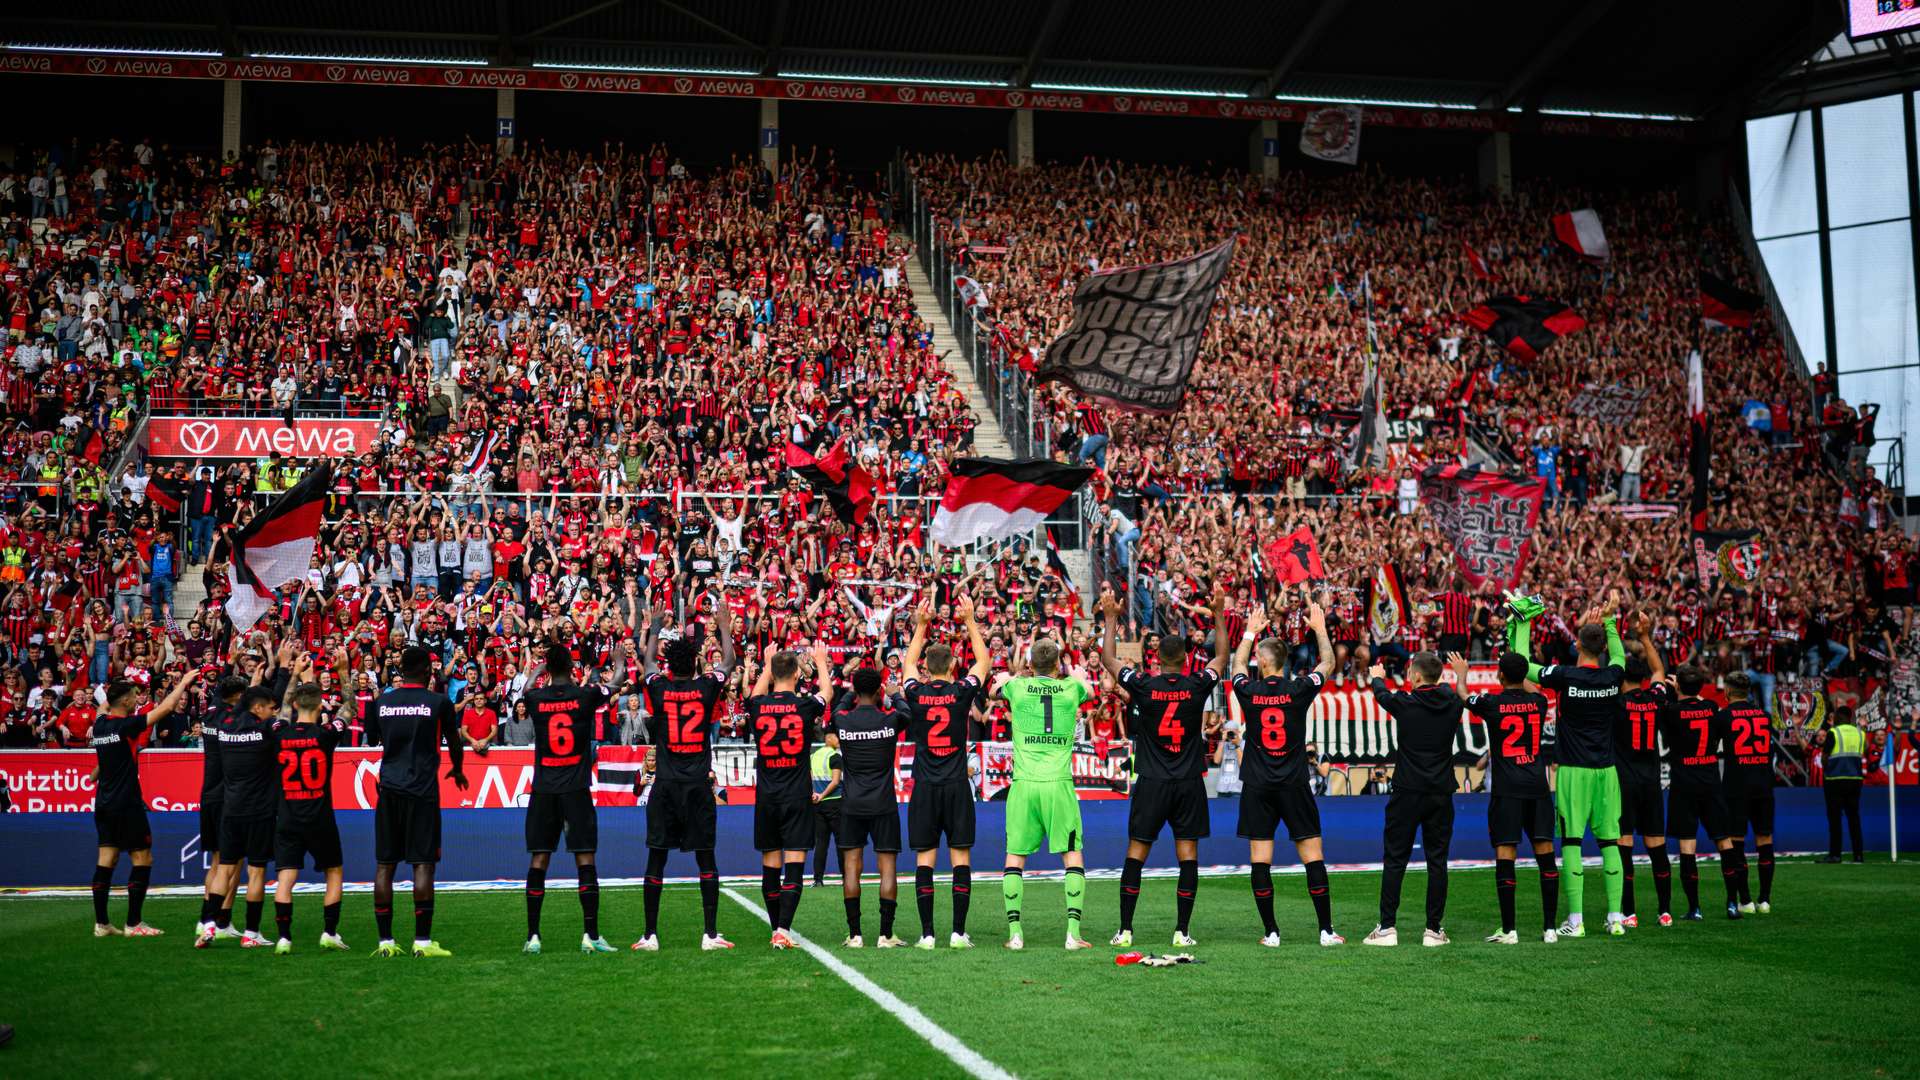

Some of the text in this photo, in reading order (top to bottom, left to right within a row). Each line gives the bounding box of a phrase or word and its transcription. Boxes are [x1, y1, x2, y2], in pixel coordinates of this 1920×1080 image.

[500, 121, 512, 135] H
[379, 704, 431, 718] Barmenia
[1568, 685, 1619, 698] Barmenia
[548, 712, 575, 756] 6
[663, 701, 705, 744] 12
[839, 727, 895, 741] Barmenia
[926, 705, 951, 748] 2
[1040, 695, 1053, 734] 1
[1158, 701, 1185, 745] 4
[1260, 706, 1287, 751] 8
[1629, 711, 1656, 751] 11
[92, 733, 121, 745] armenia
[755, 714, 805, 757] 23
[1024, 735, 1069, 747] HRADECKY
[1499, 713, 1541, 758] 21
[1689, 719, 1709, 757] 7
[1731, 717, 1770, 756] 25
[0, 768, 96, 793] utztüc
[278, 748, 327, 791] 20
